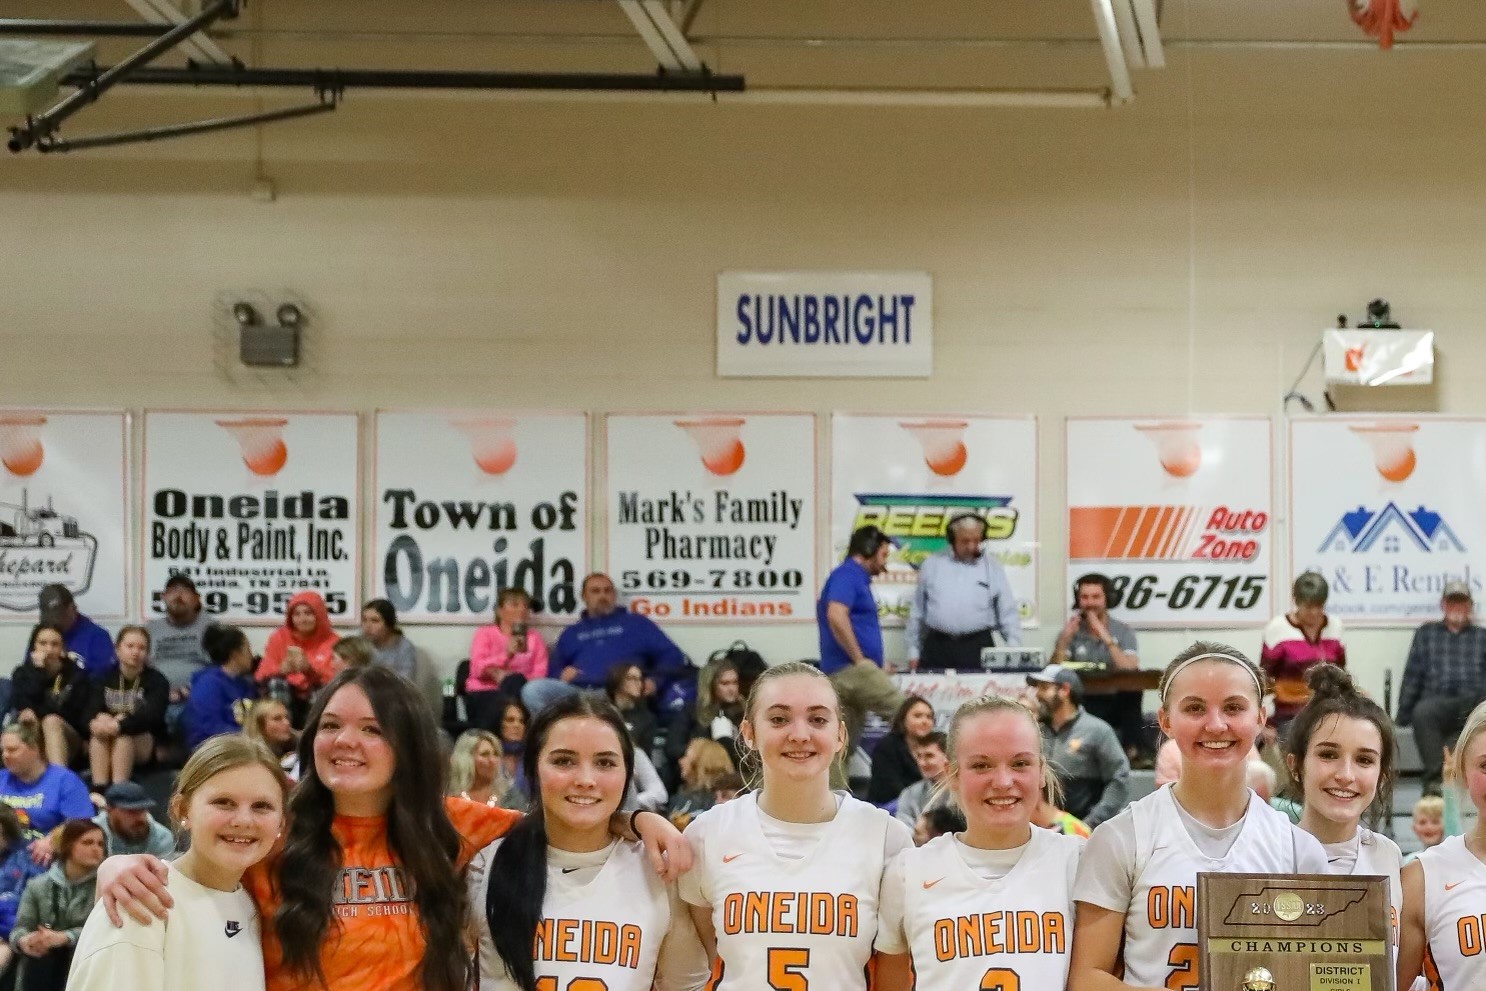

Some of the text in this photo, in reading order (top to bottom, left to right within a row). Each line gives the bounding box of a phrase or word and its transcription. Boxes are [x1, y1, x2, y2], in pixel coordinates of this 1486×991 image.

[736, 293, 915, 346] SUNBRIGHT
[153, 488, 349, 519] Oneida
[383, 488, 578, 531] Town of
[618, 489, 803, 529] Mark's Family
[1205, 504, 1269, 532] Auto
[152, 520, 210, 564] Body
[215, 527, 231, 561] &
[307, 522, 350, 561] Inc.
[645, 527, 777, 565] Pharmacy
[1190, 533, 1259, 560] Zone
[206, 566, 302, 577] Industrial
[249, 579, 271, 588] TN
[384, 534, 577, 614] Oneida
[621, 568, 803, 589] 569-7800
[1332, 565, 1352, 594] &
[1365, 564, 1384, 593] E
[151, 591, 348, 615] 59-955
[630, 598, 793, 617] Go Indians
[723, 891, 859, 938] ONEIDA
[1251, 902, 1325, 915] 20 23
[532, 917, 642, 969] NEIDA
[933, 910, 1066, 962] ONEIDA
[1230, 940, 1364, 954] CHAMPIONS
[1315, 966, 1364, 975] DISTRICT
[1320, 977, 1354, 985] DIVISION
